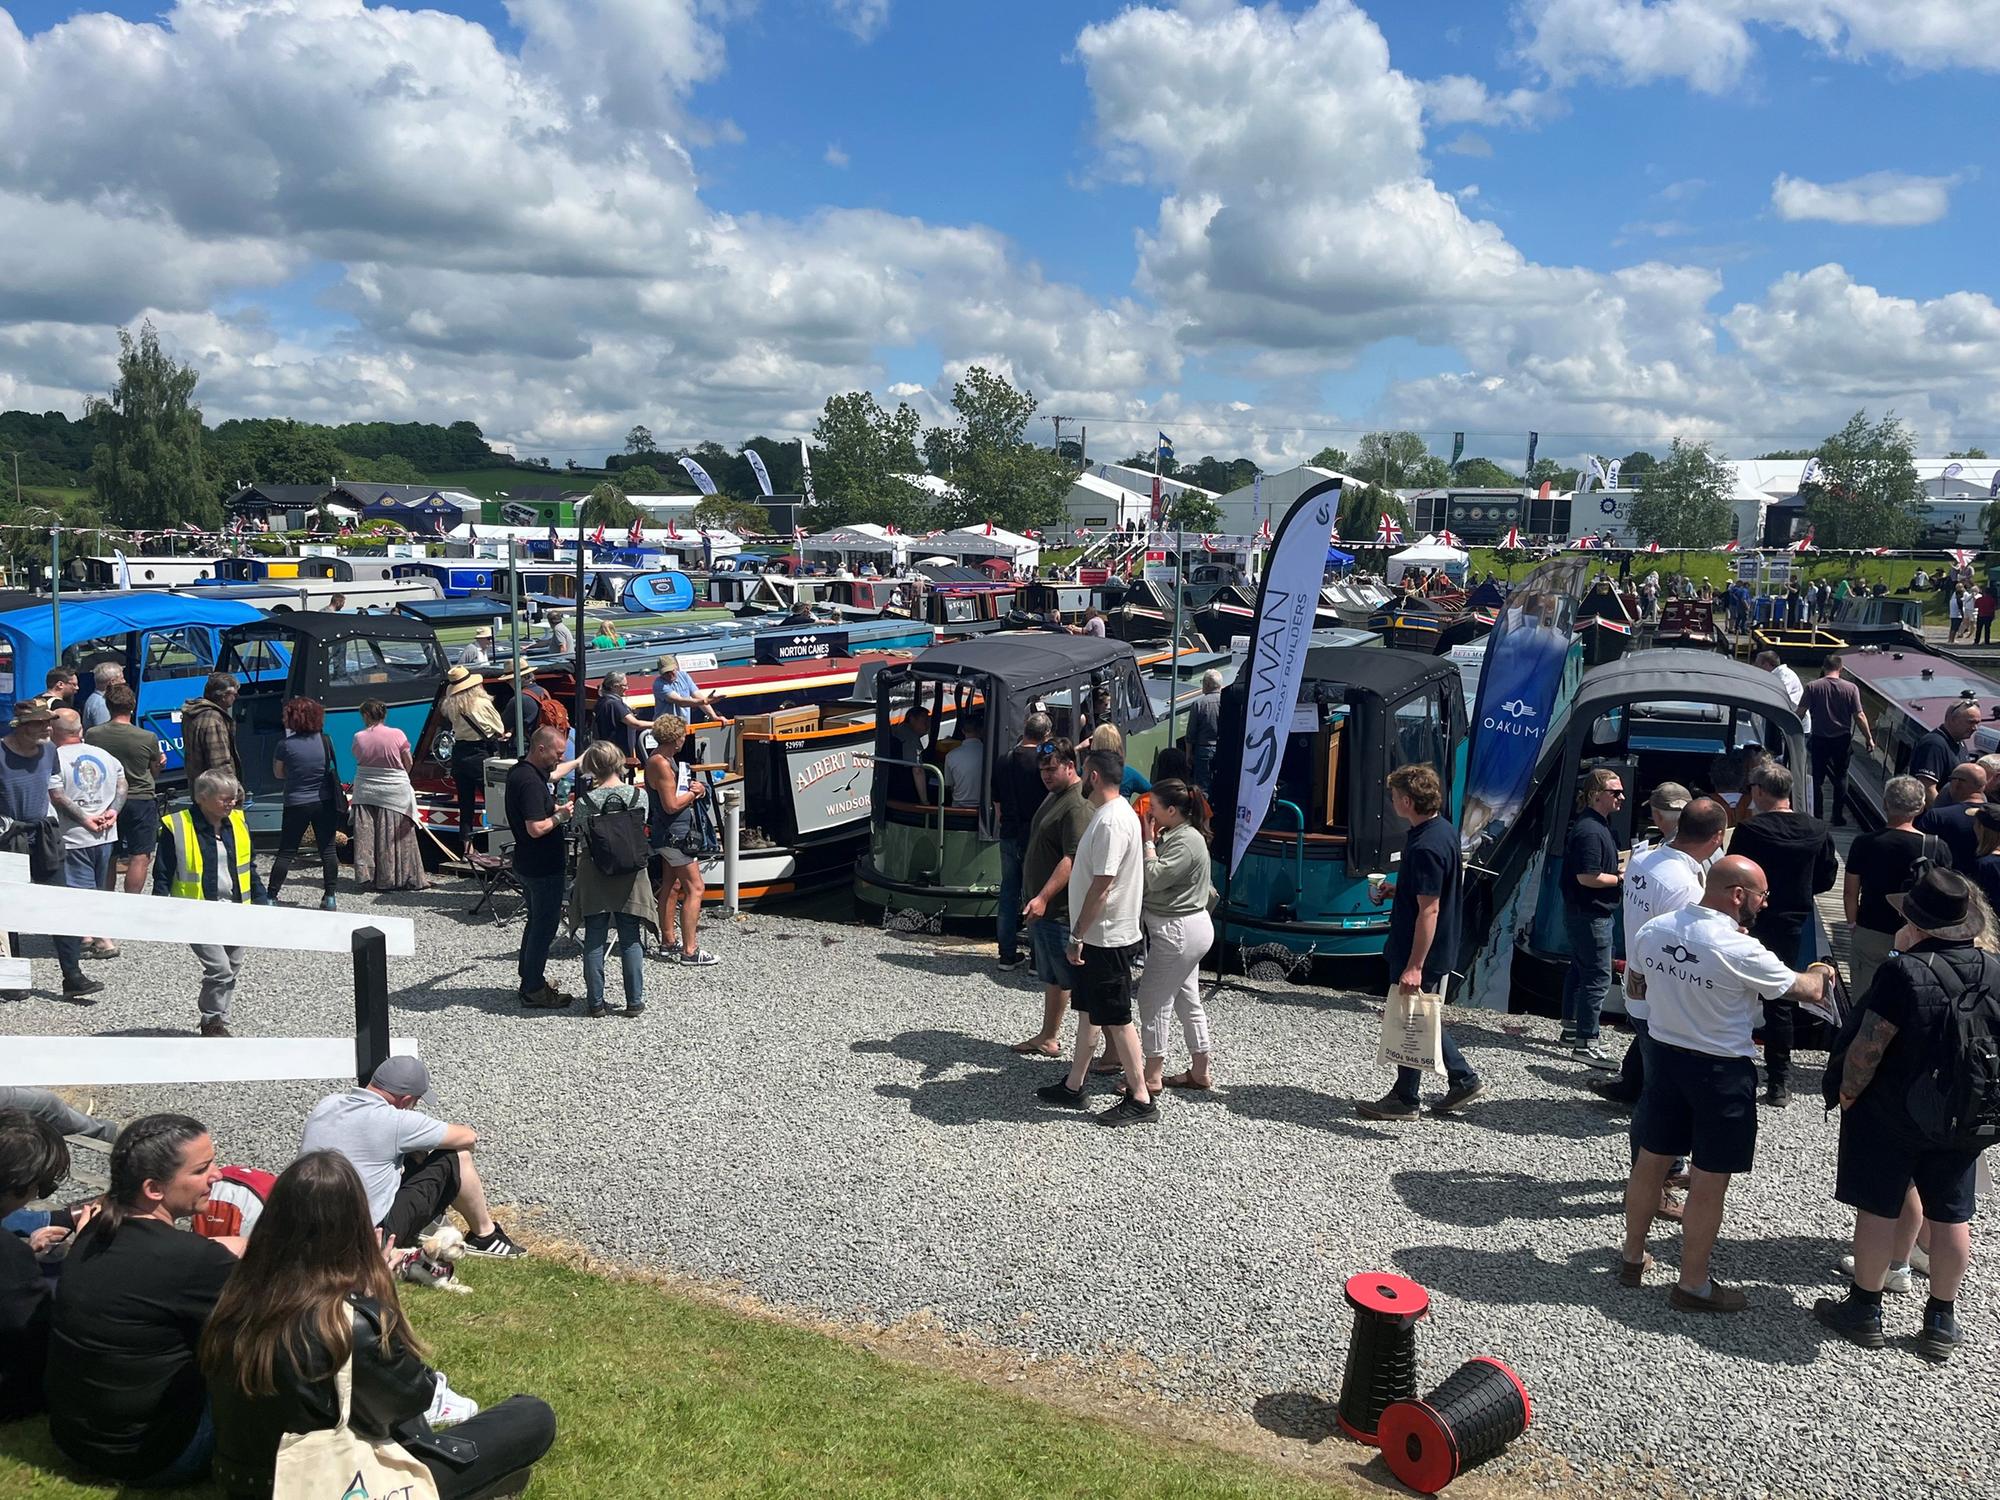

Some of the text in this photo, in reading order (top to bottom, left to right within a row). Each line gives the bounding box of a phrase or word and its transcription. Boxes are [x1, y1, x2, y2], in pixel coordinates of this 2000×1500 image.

[1609, 467, 1617, 489] LINE
[779, 643, 829, 657] NORTON CANES
[1252, 590, 1289, 719] SWAN
[1484, 718, 1545, 738] OAKUM
[796, 752, 847, 792] ALBERT
[826, 795, 871, 816] WINDSOR
[1645, 957, 1714, 989] OAKUMS
